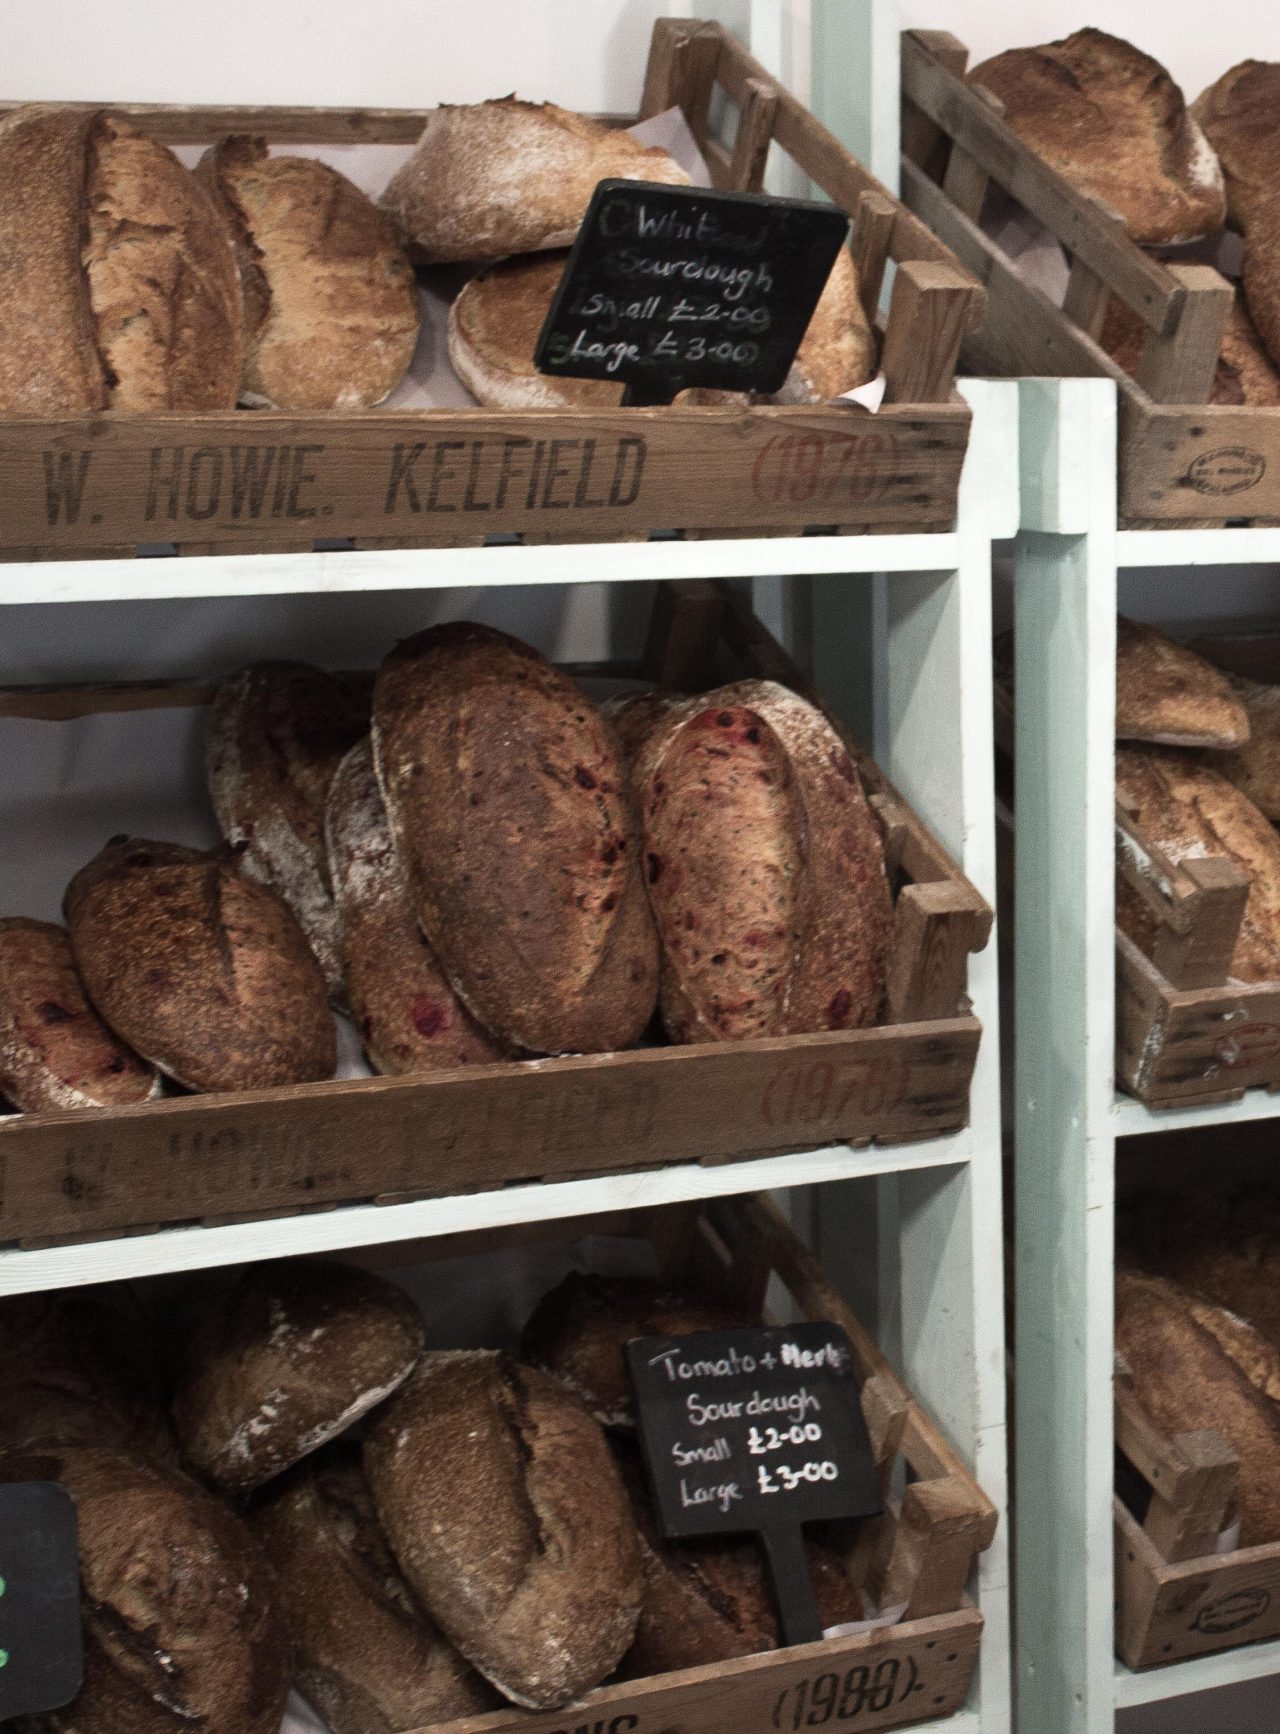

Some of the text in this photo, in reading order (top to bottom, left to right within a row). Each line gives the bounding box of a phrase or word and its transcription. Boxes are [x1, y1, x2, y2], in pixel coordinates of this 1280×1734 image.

[615, 249, 773, 300] Sourdough
[580, 294, 661, 319] Small
[570, 329, 641, 372] Large
[42, 450, 103, 525] W.
[384, 437, 648, 513] KELFIELD
[648, 1347, 757, 1382] Tomato
[685, 1387, 821, 1426] Sourdough
[671, 1437, 732, 1467] Small
[680, 1478, 743, 1513] Large
